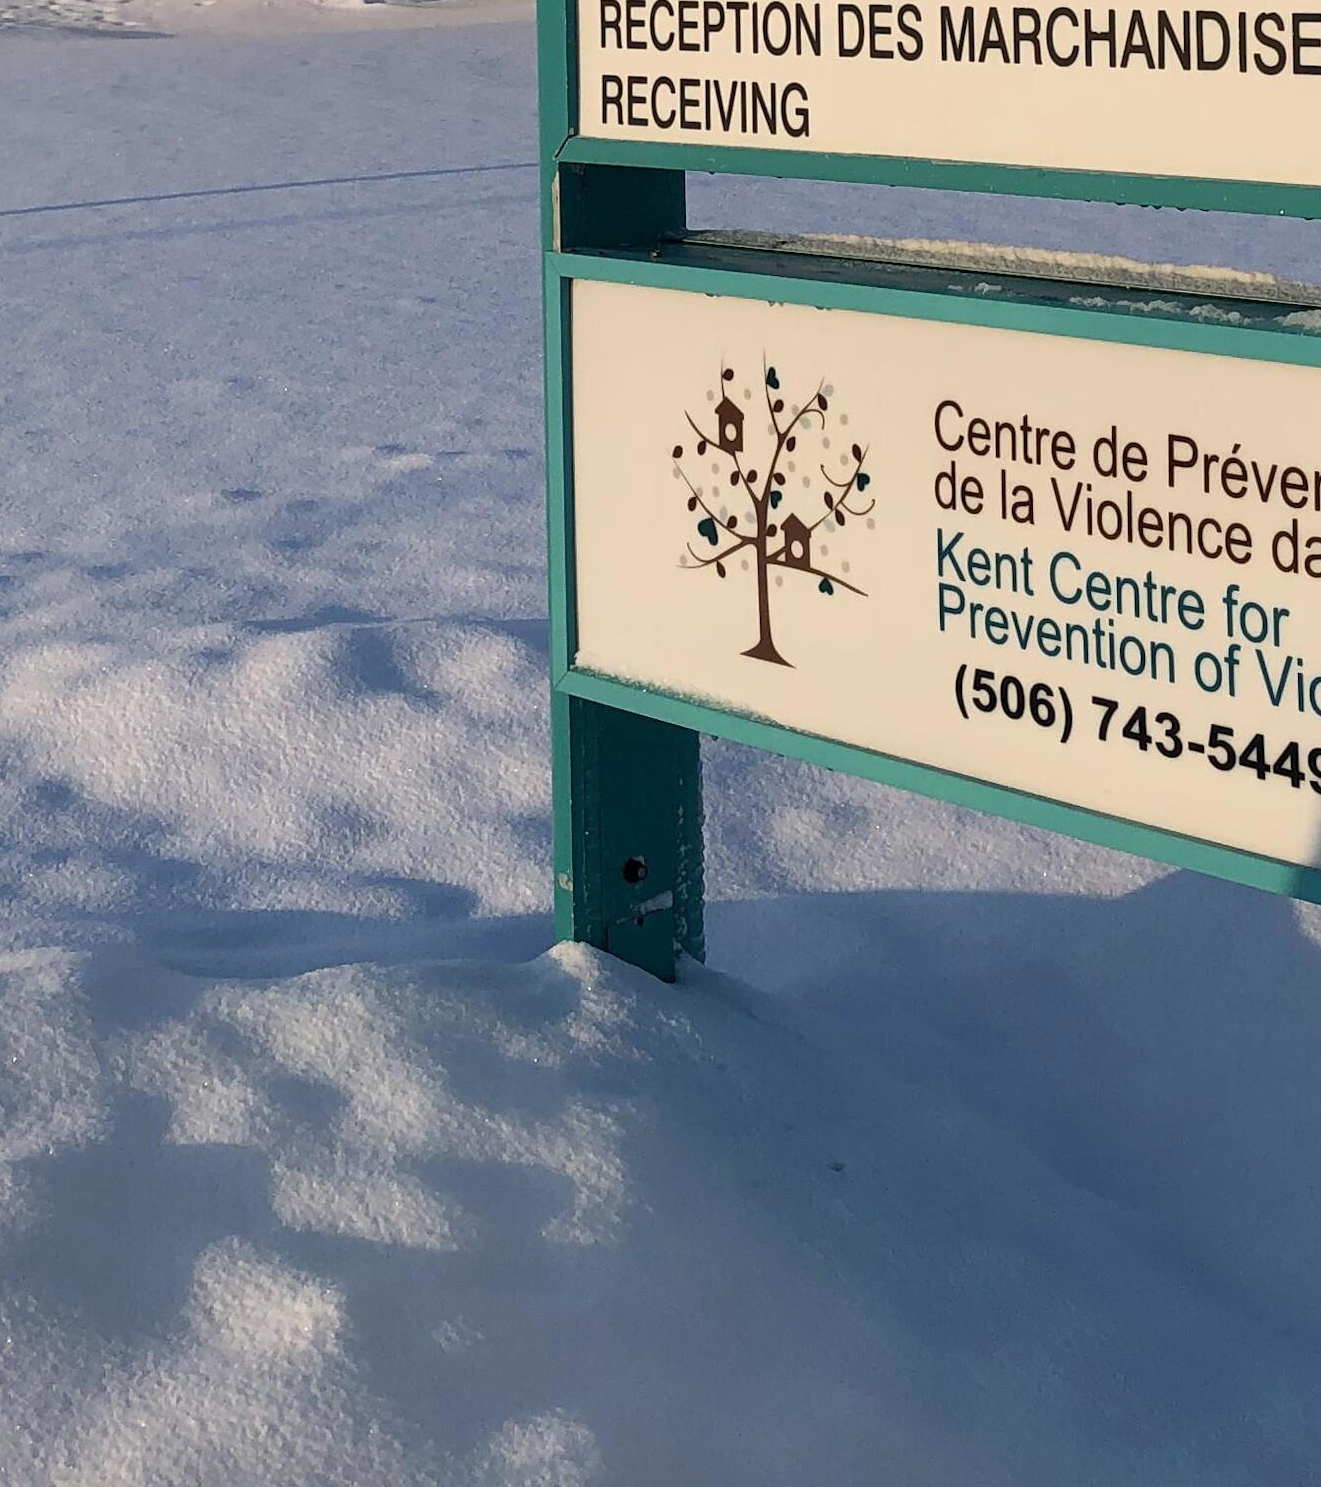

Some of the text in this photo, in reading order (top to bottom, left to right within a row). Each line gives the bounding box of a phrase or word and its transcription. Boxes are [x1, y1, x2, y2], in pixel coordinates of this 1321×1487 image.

[837, 3, 924, 62] DES
[601, 74, 810, 138] RECEIVING
[934, 399, 1076, 471] Centre
[1093, 425, 1148, 483] de
[934, 460, 984, 515] de
[1000, 468, 1035, 526] la
[1050, 477, 1253, 565] Violence
[936, 527, 1291, 648] Kent Centre for
[938, 582, 1176, 684] Prevention
[1194, 643, 1242, 698] of
[954, 663, 1073, 744] (506)
